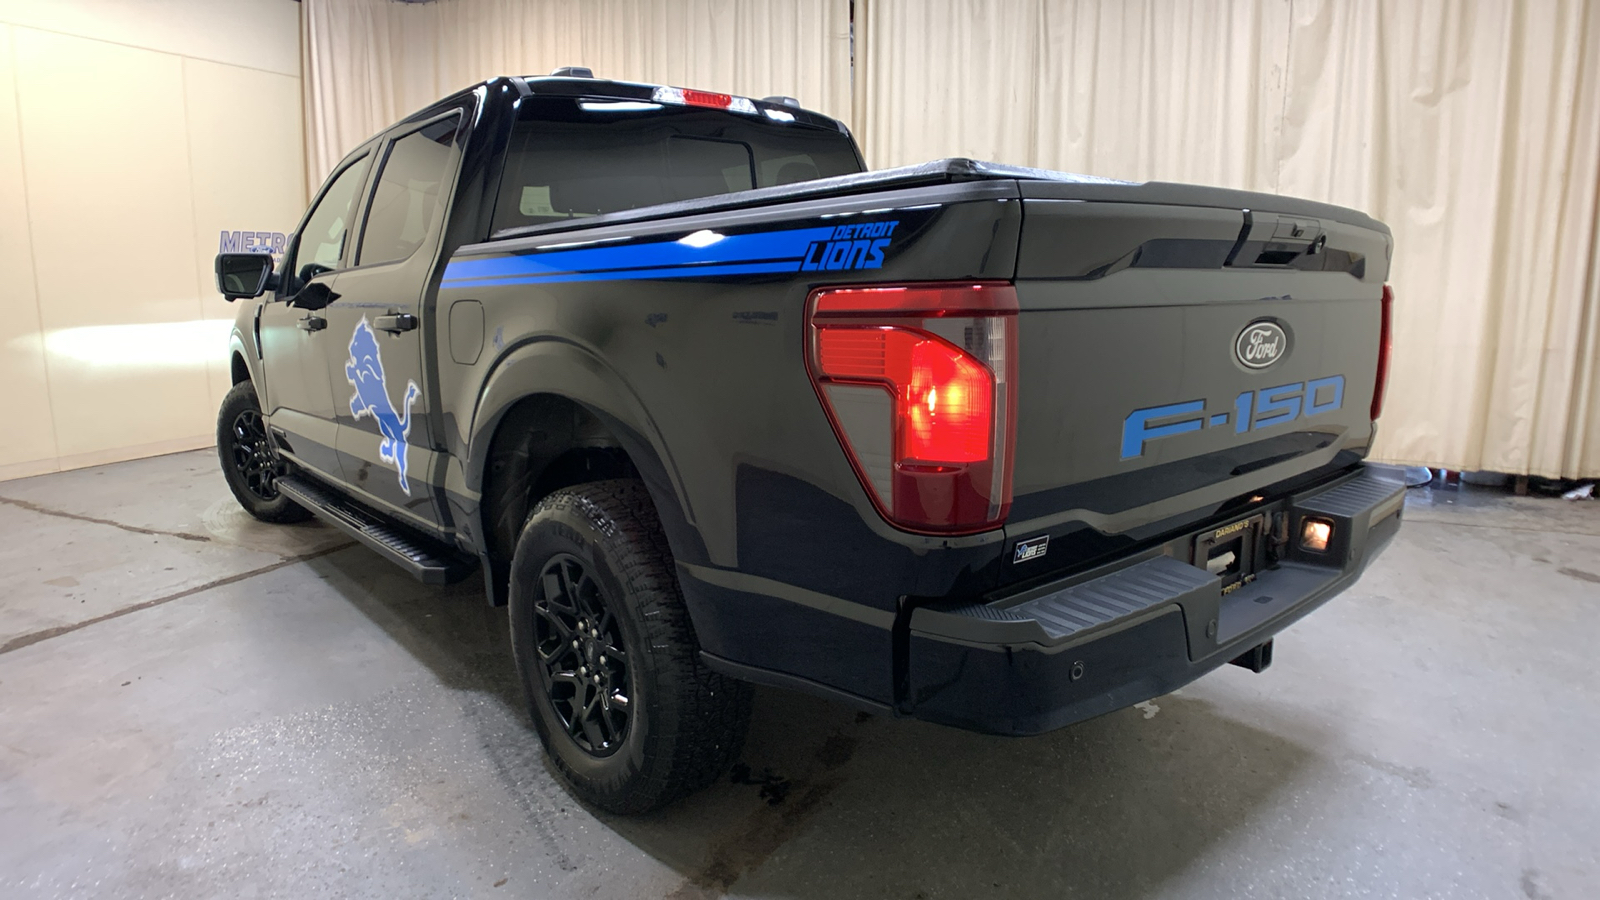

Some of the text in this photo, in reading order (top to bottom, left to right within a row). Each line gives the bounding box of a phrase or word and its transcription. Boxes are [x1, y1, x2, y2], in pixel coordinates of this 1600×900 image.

[832, 220, 900, 240] DETROIT
[800, 238, 893, 272] LIONS
[1246, 328, 1279, 360] Ford
[1119, 374, 1346, 461] F-150
